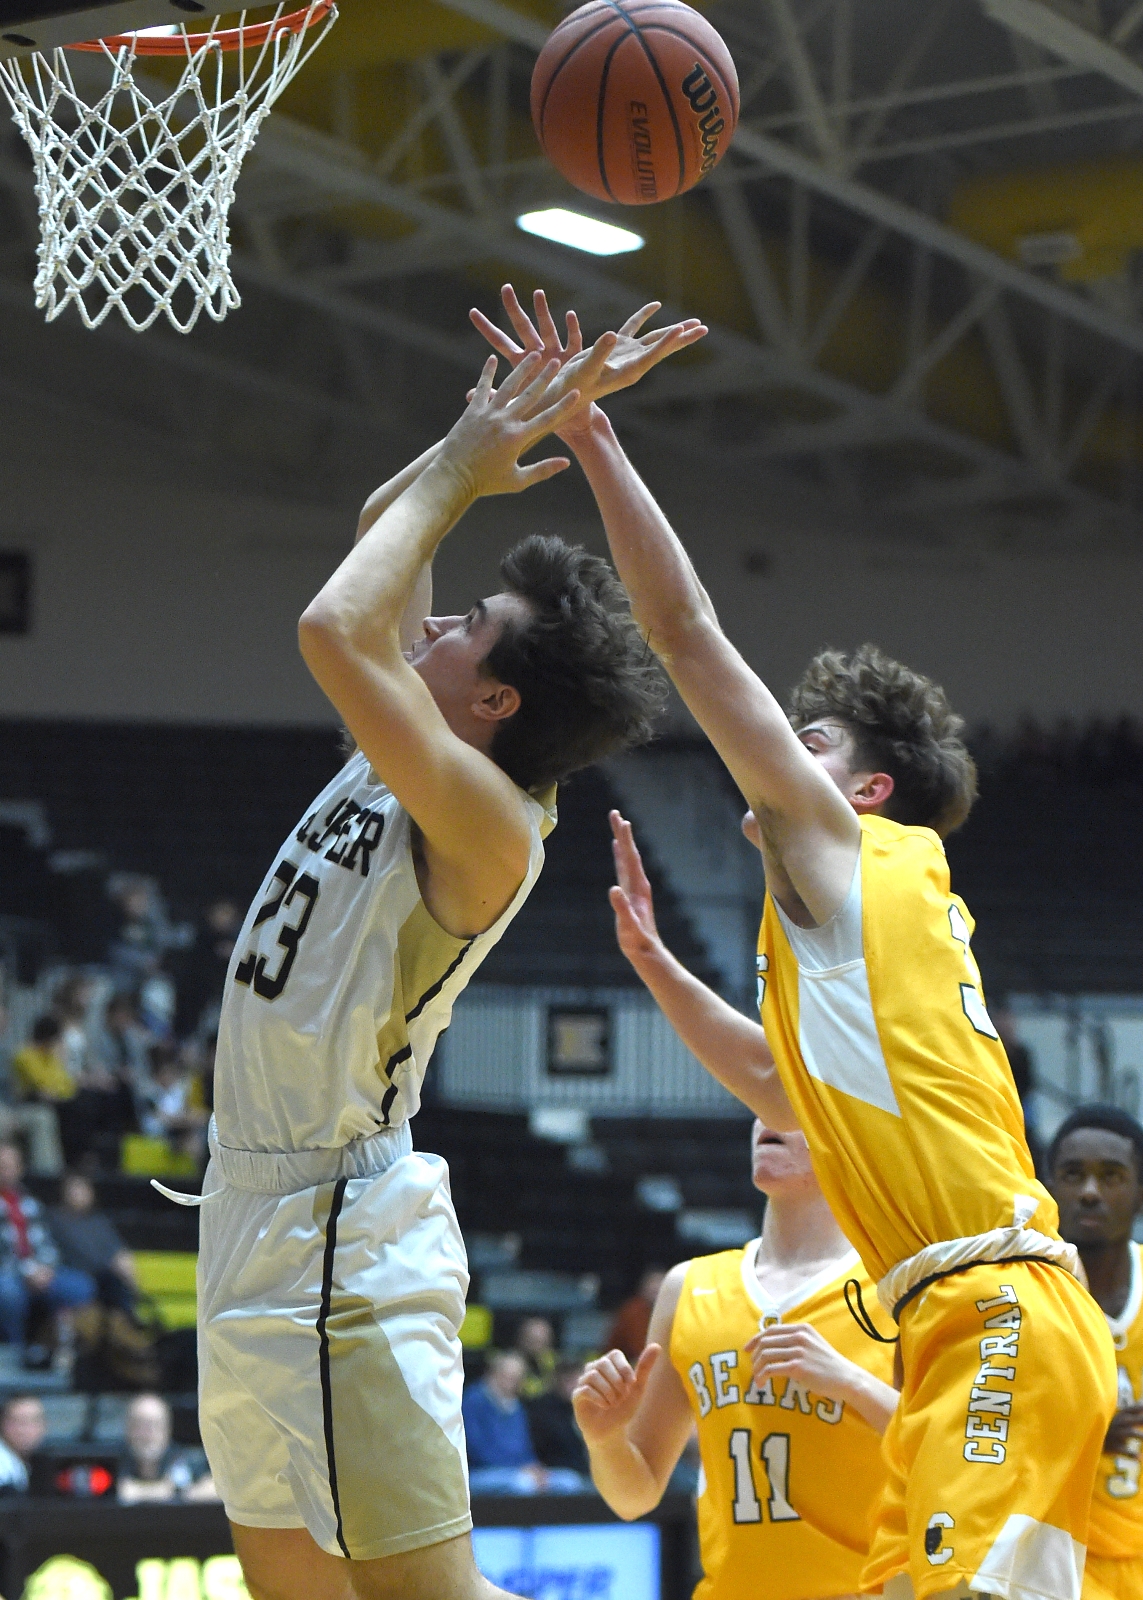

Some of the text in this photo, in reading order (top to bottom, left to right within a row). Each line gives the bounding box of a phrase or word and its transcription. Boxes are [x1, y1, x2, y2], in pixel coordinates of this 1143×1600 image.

[681, 61, 725, 177] Wilso
[234, 859, 320, 1004] 23
[962, 1284, 1022, 1466] CENTRAL
[729, 1428, 802, 1526] 11
